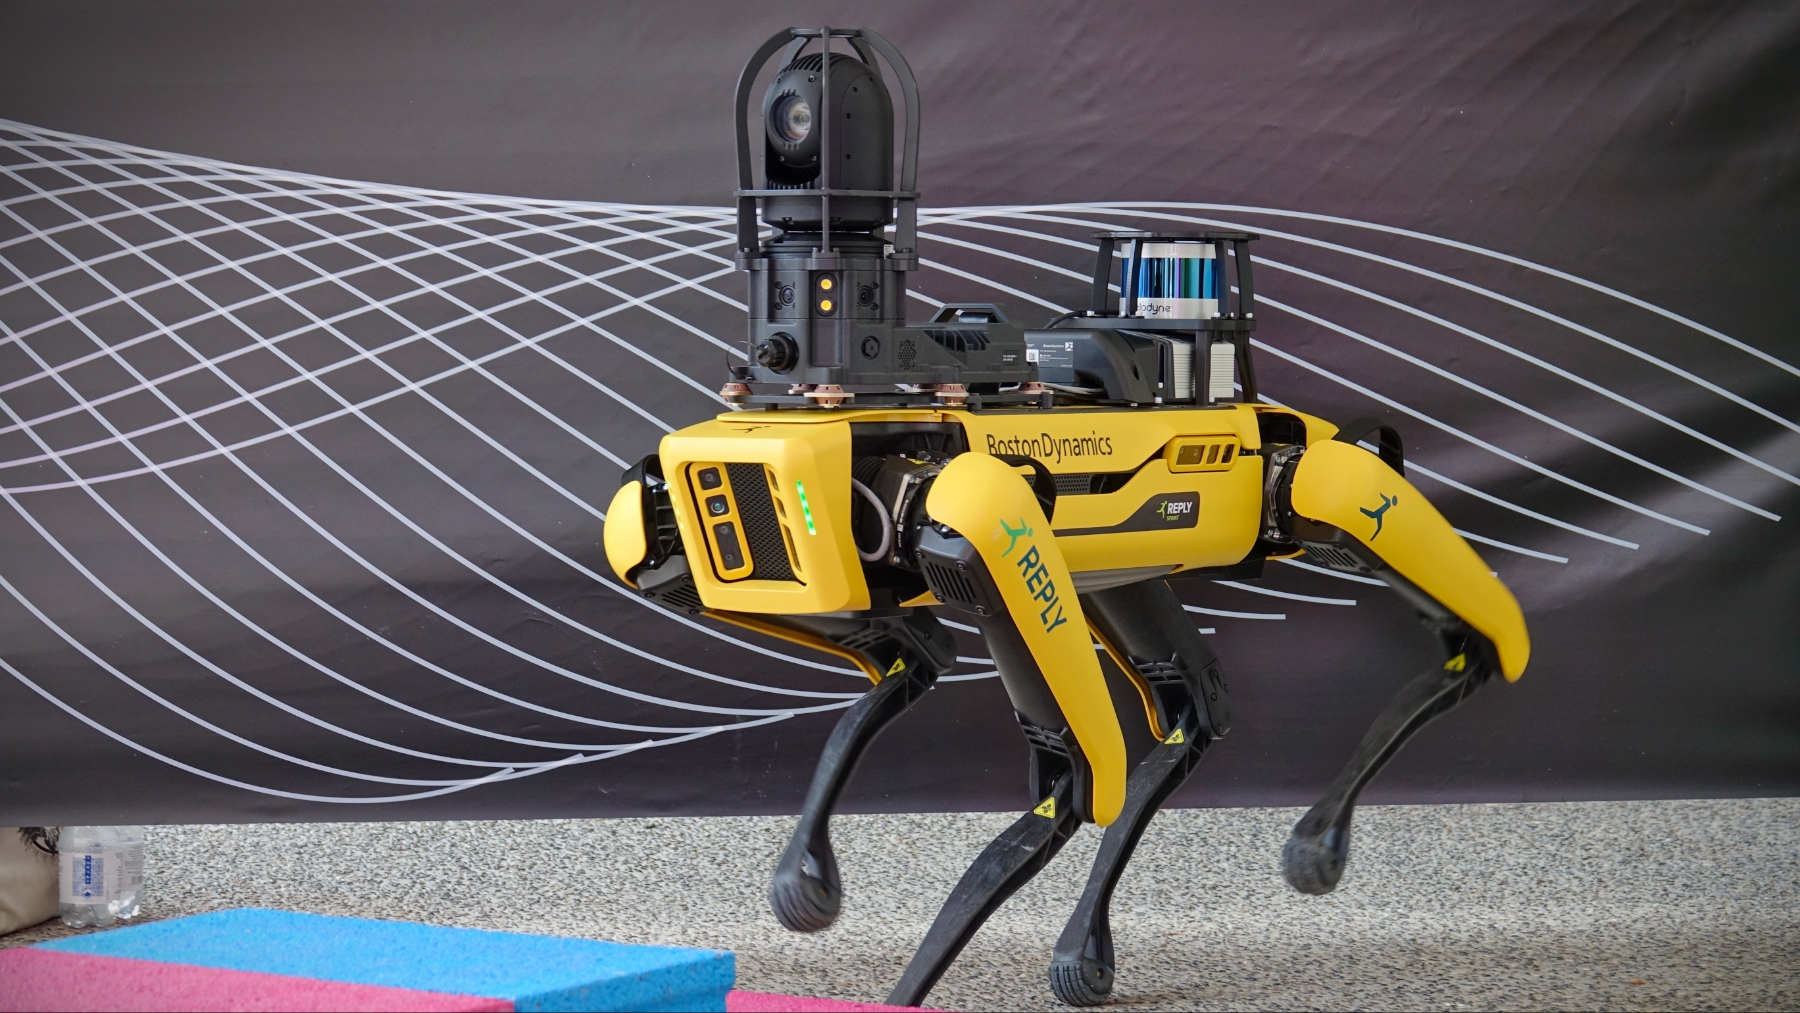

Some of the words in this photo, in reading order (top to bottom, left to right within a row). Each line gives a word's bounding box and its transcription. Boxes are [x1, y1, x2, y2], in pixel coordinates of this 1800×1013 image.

[986, 430, 1113, 464] BostonDynamics
[1167, 501, 1193, 515] REPLY
[1016, 544, 1068, 634] REPLY
